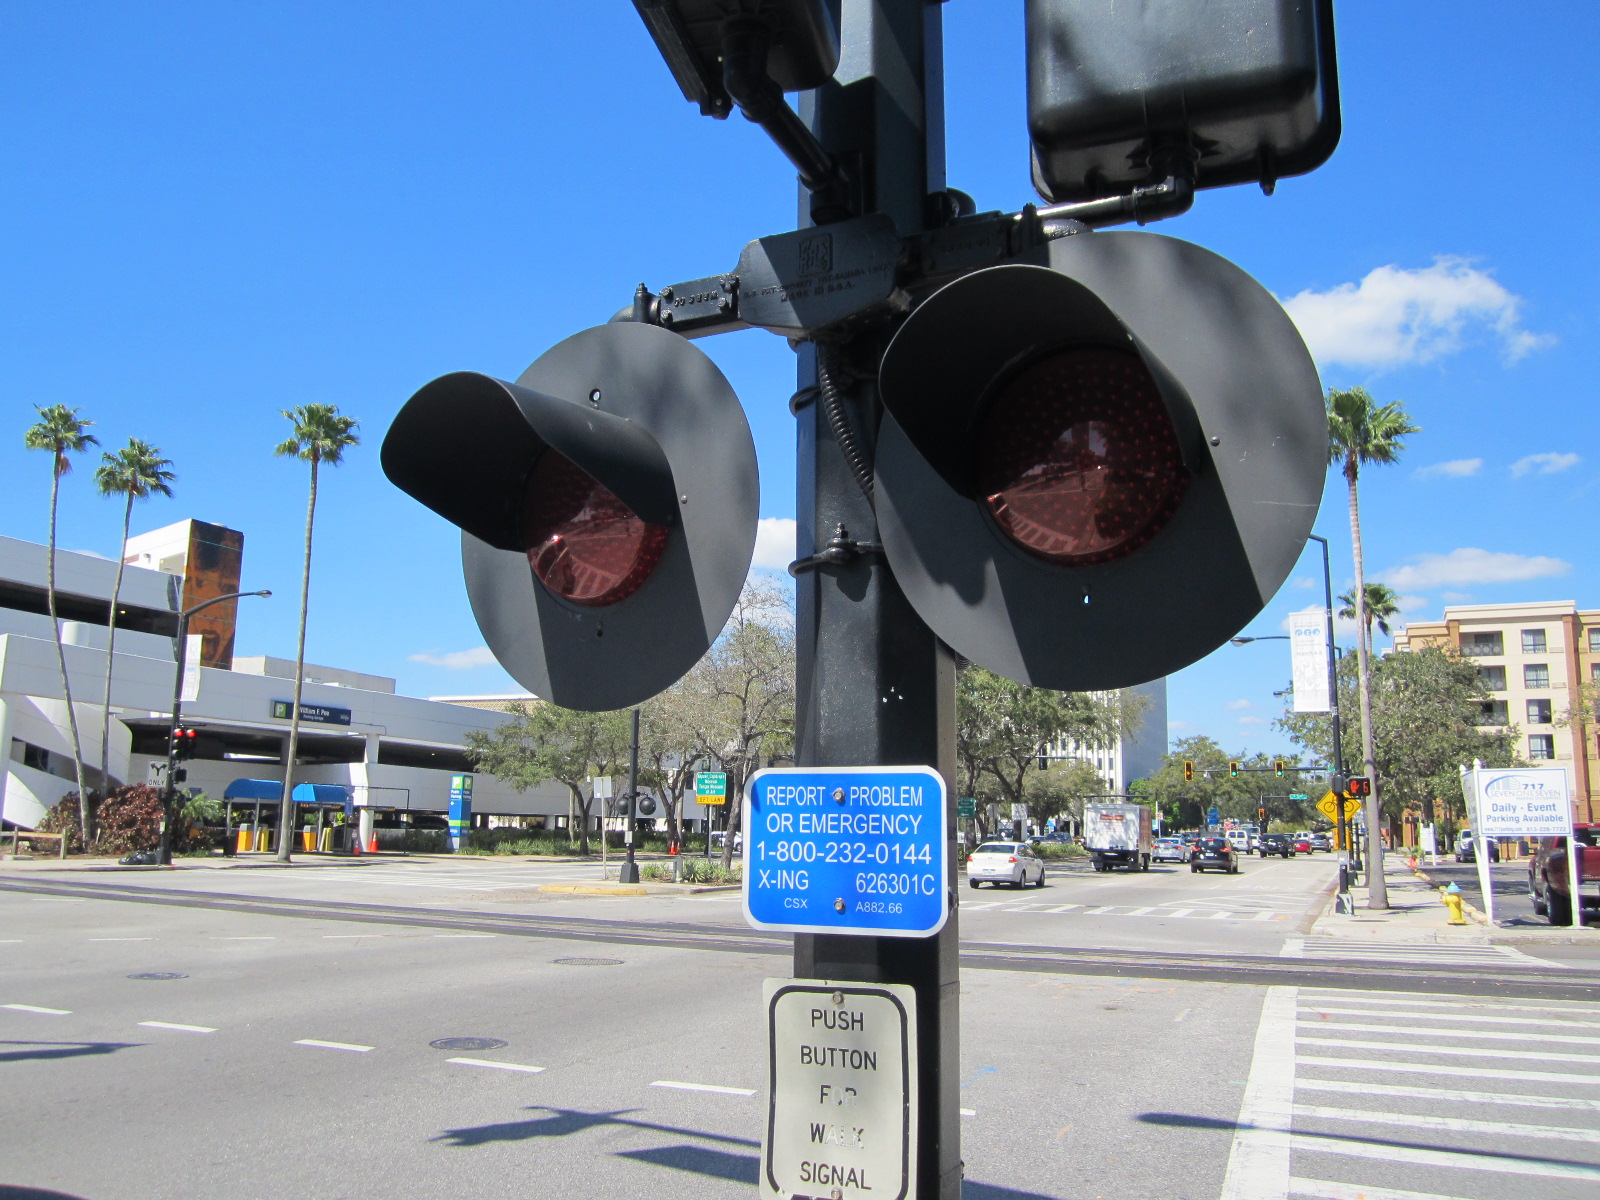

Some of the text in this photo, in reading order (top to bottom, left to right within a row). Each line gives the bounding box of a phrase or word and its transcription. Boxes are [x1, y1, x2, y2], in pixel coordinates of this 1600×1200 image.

[767, 786, 923, 807] REPORT PROBLEM
[1491, 802, 1557, 813] Daily Event
[767, 813, 923, 835] OR EMERGENCY
[1486, 814, 1564, 824] Parking Available
[757, 841, 932, 865] 1-800-232-0144
[758, 869, 936, 896] X-ING 626301C
[784, 898, 903, 914] CSX A882.66
[811, 1008, 864, 1031] PUSH
[800, 1045, 877, 1071] BUTTON
[799, 1160, 872, 1190] SIGNAL
